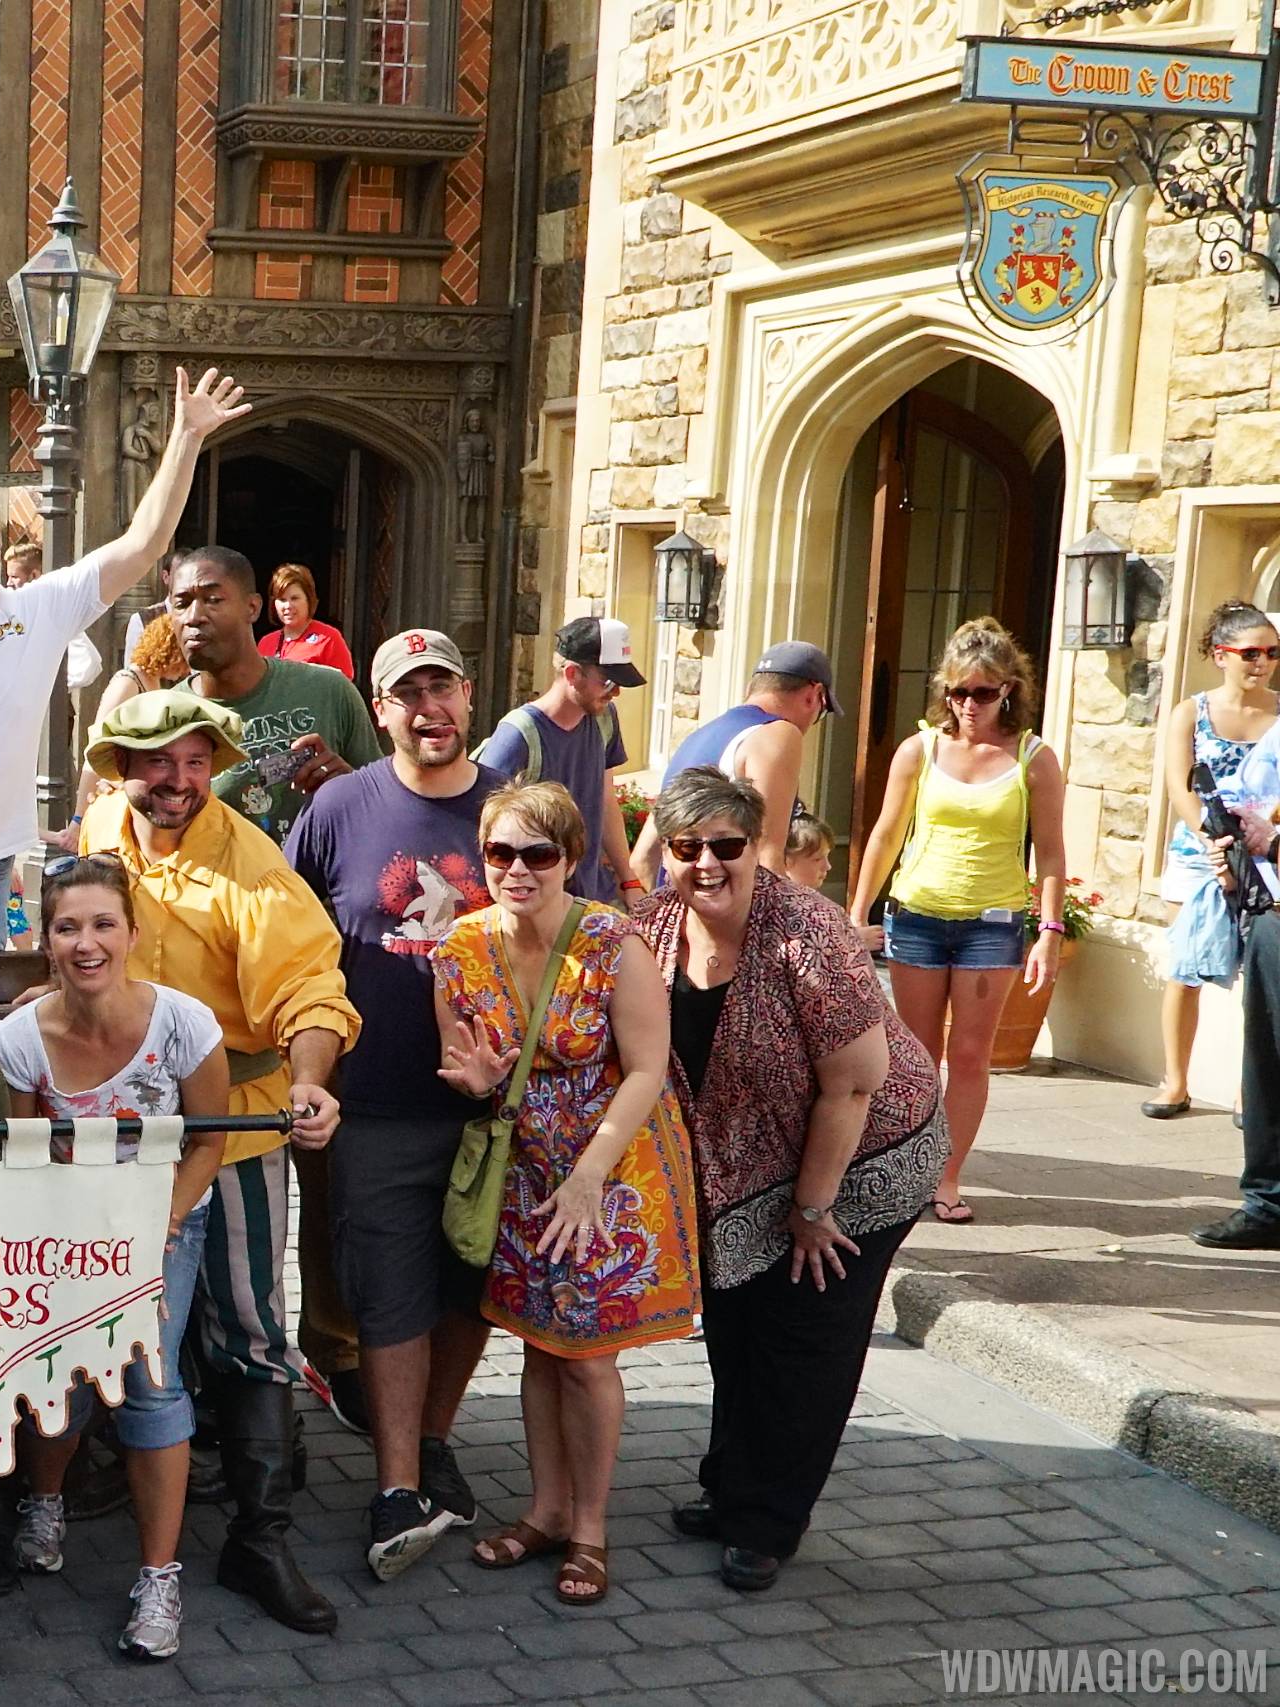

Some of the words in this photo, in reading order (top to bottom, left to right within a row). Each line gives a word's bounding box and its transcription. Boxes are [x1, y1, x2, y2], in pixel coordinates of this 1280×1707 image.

[1008, 56, 1041, 85] The
[1046, 53, 1130, 96] Crown
[1136, 68, 1160, 97] &
[1162, 60, 1234, 103] Crest
[997, 187, 1035, 207] Historical
[1036, 185, 1071, 201] Research
[404, 633, 427, 655] B
